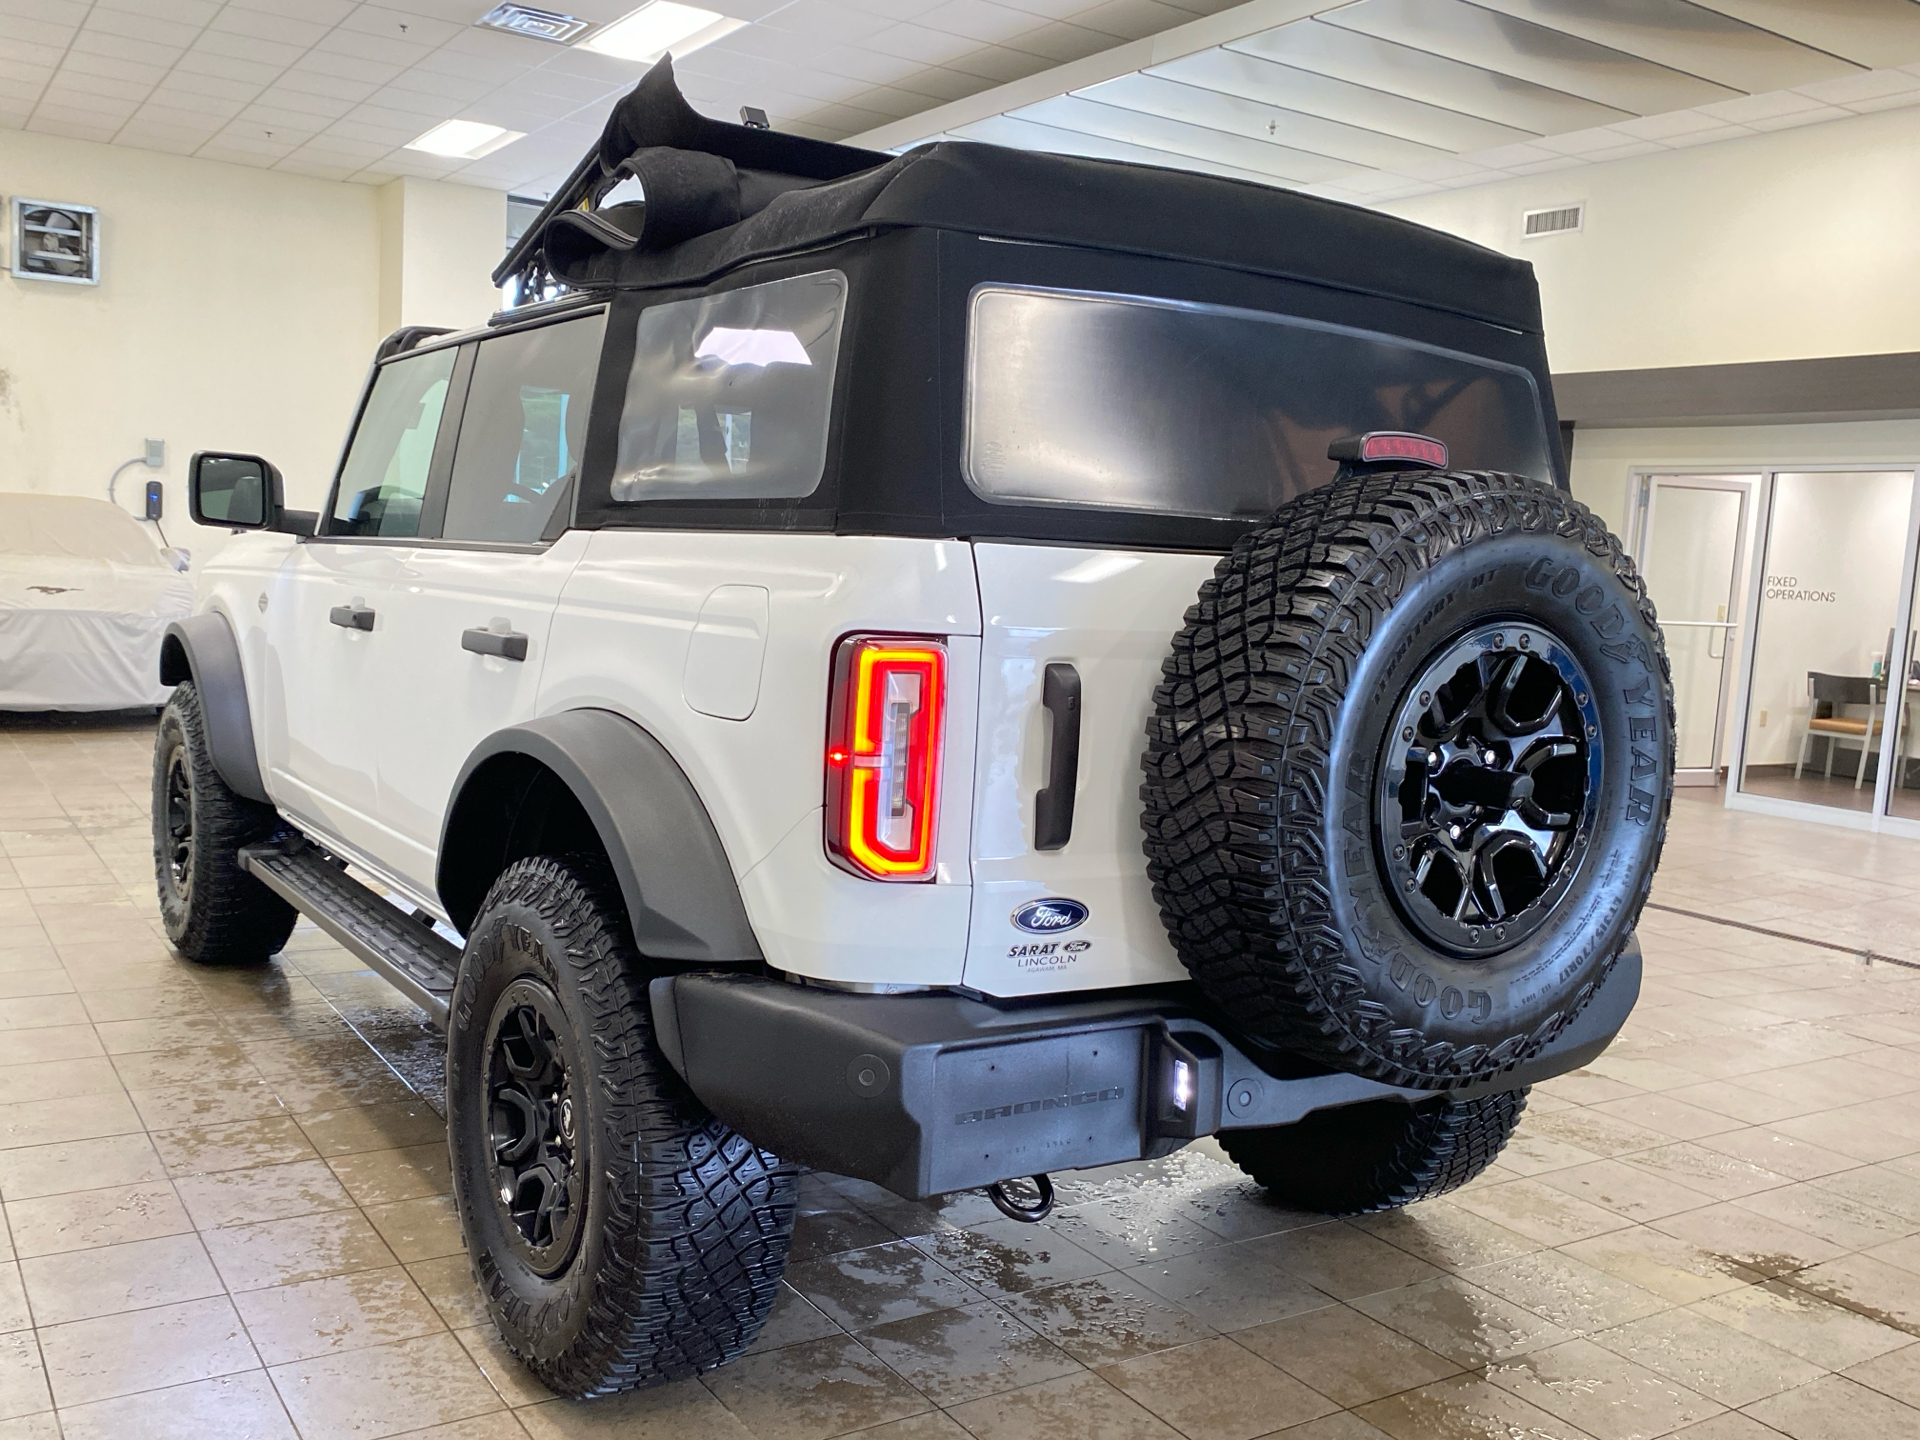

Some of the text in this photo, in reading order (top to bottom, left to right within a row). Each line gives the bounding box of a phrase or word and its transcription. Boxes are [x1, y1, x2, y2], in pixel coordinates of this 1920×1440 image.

[1767, 576, 1797, 587] FIXED
[1766, 588, 1836, 602] OPERATIONS
[1031, 905, 1073, 928] Ford
[1008, 942, 1060, 957] SARAT
[1017, 954, 1077, 968] LINCOLN
[955, 1087, 1124, 1125] BRONCO
